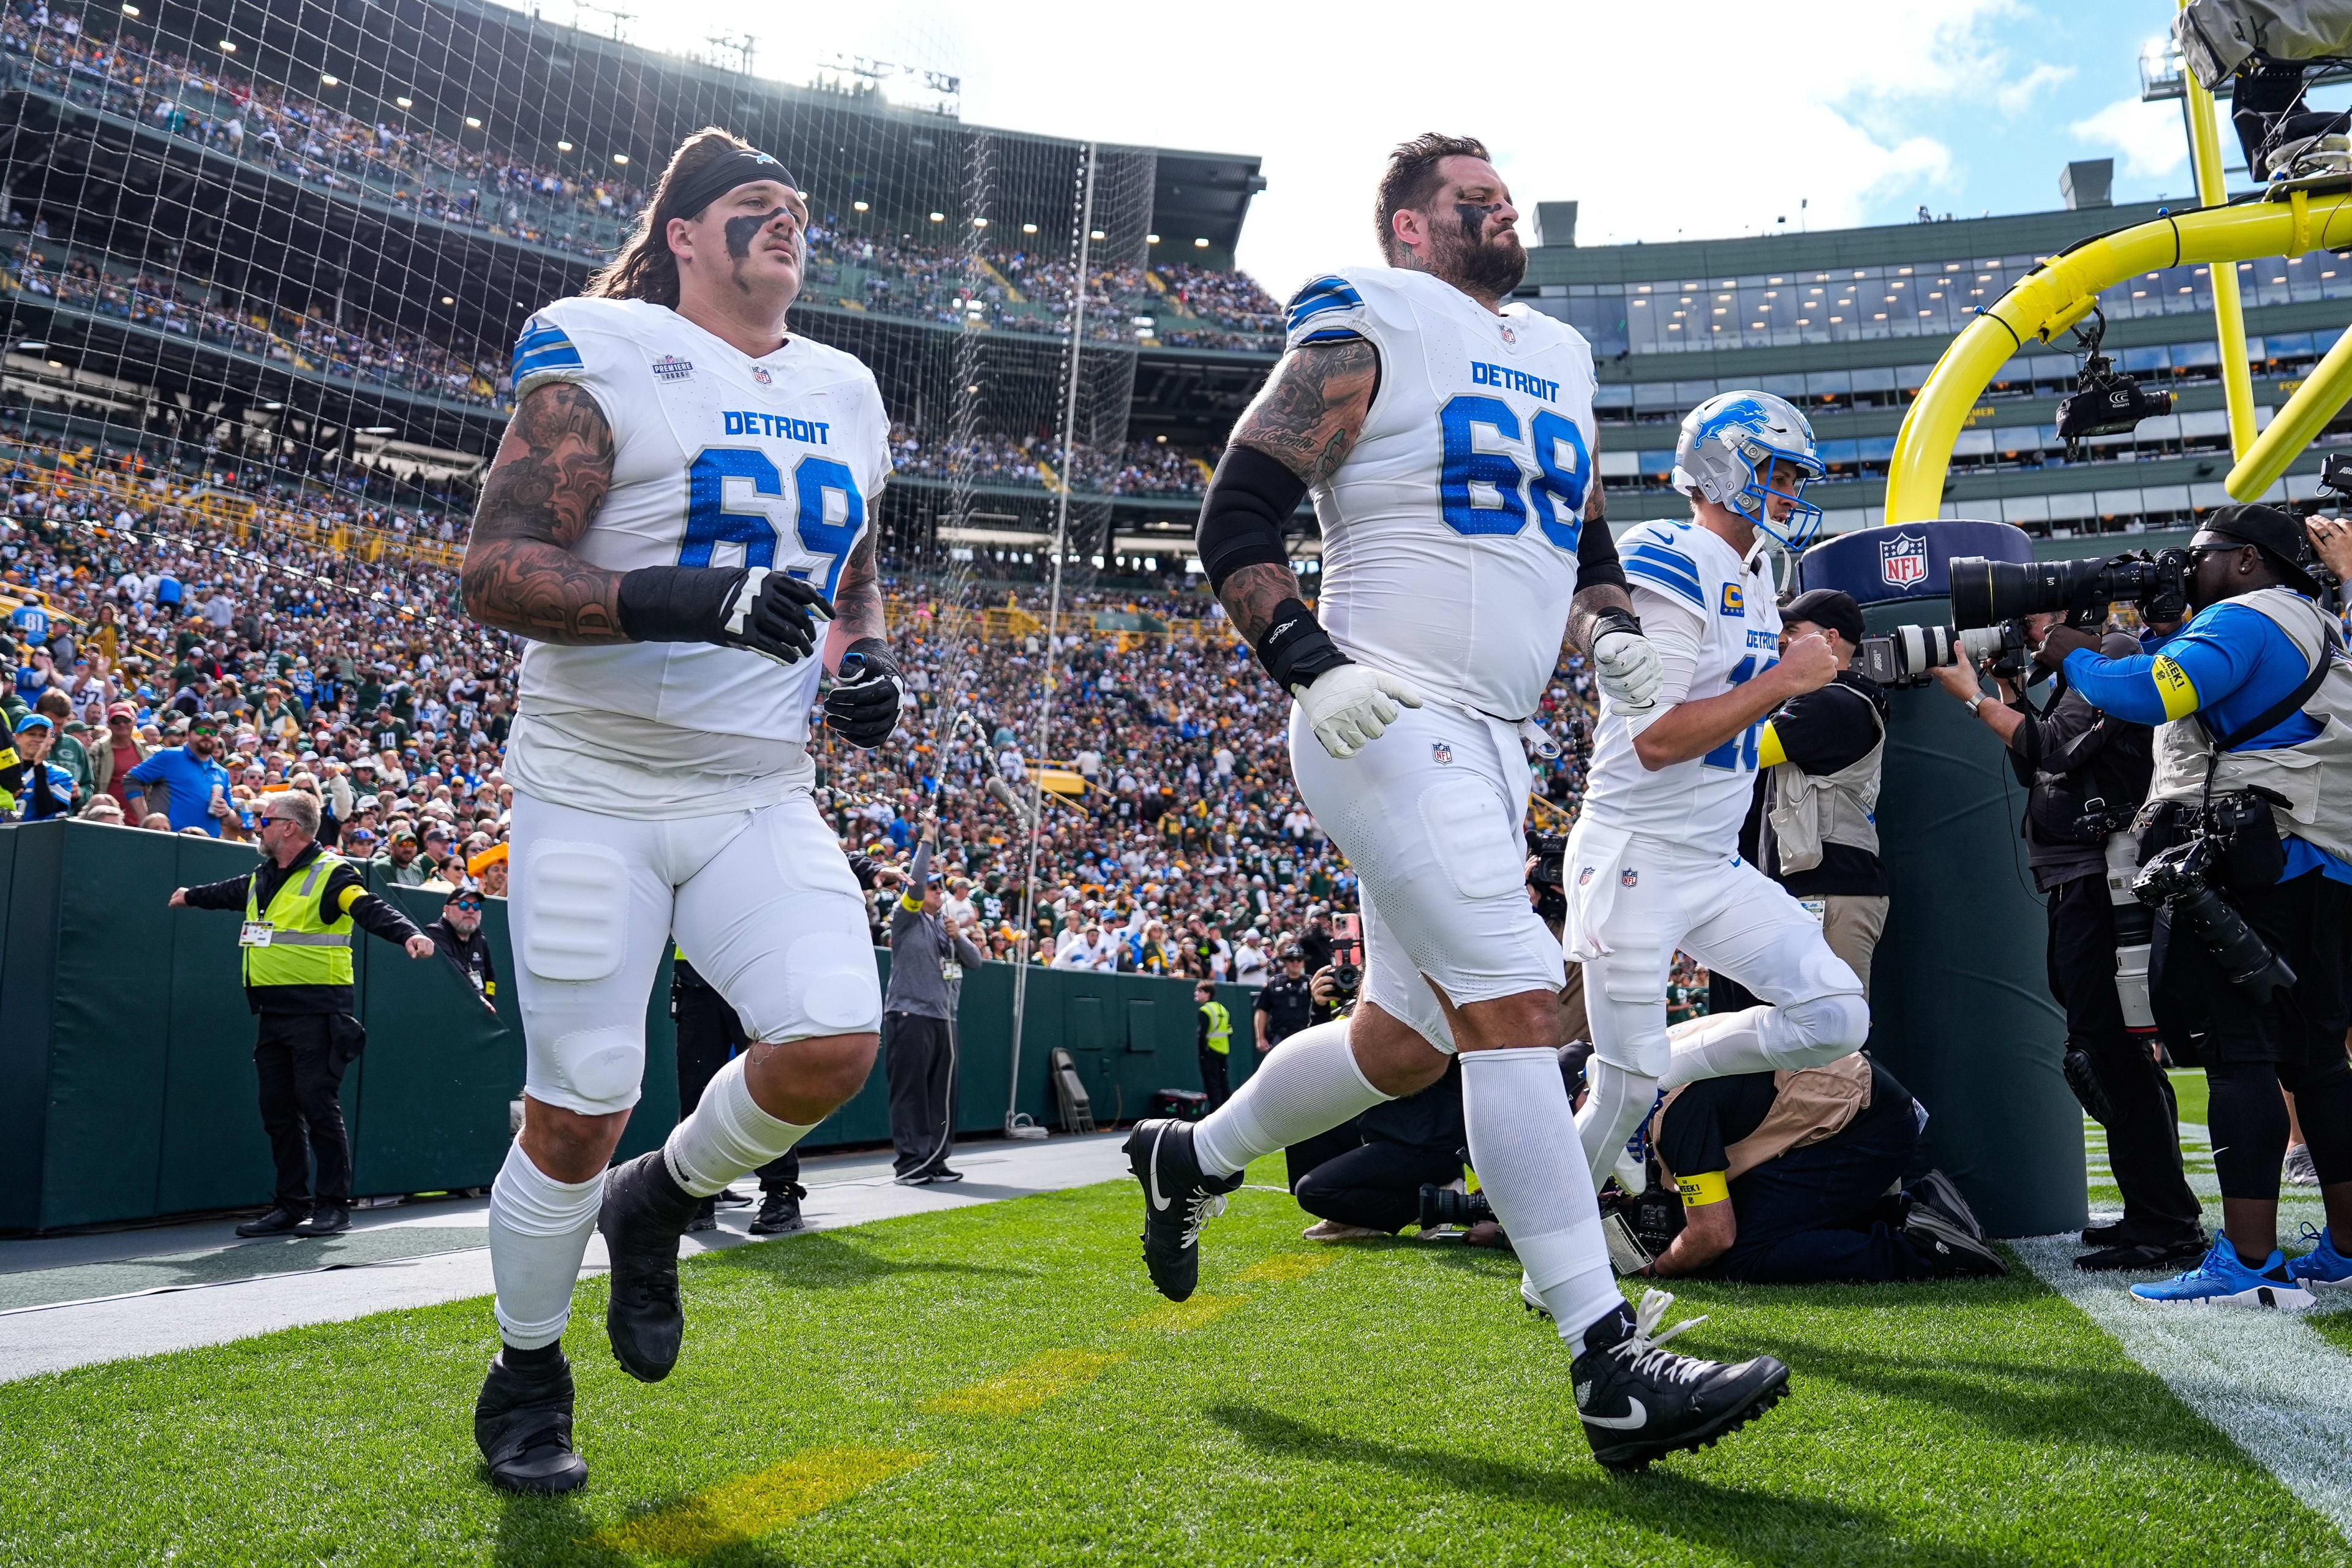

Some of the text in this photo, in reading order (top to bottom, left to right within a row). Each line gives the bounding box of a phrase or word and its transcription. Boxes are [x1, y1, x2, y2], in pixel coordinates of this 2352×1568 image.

[1470, 361, 1559, 403] DETROIT
[721, 411, 830, 445] DETROIT
[1435, 392, 1593, 556] 68
[2339, 466, 2352, 475] AR
[673, 443, 870, 606] 69
[1887, 557, 1923, 581] NFL
[1724, 584, 1743, 608] C
[23, 612, 44, 632] 81
[1874, 653, 1883, 671] ARRI
[2162, 656, 2182, 682] WEEK
[75, 690, 99, 705] 97
